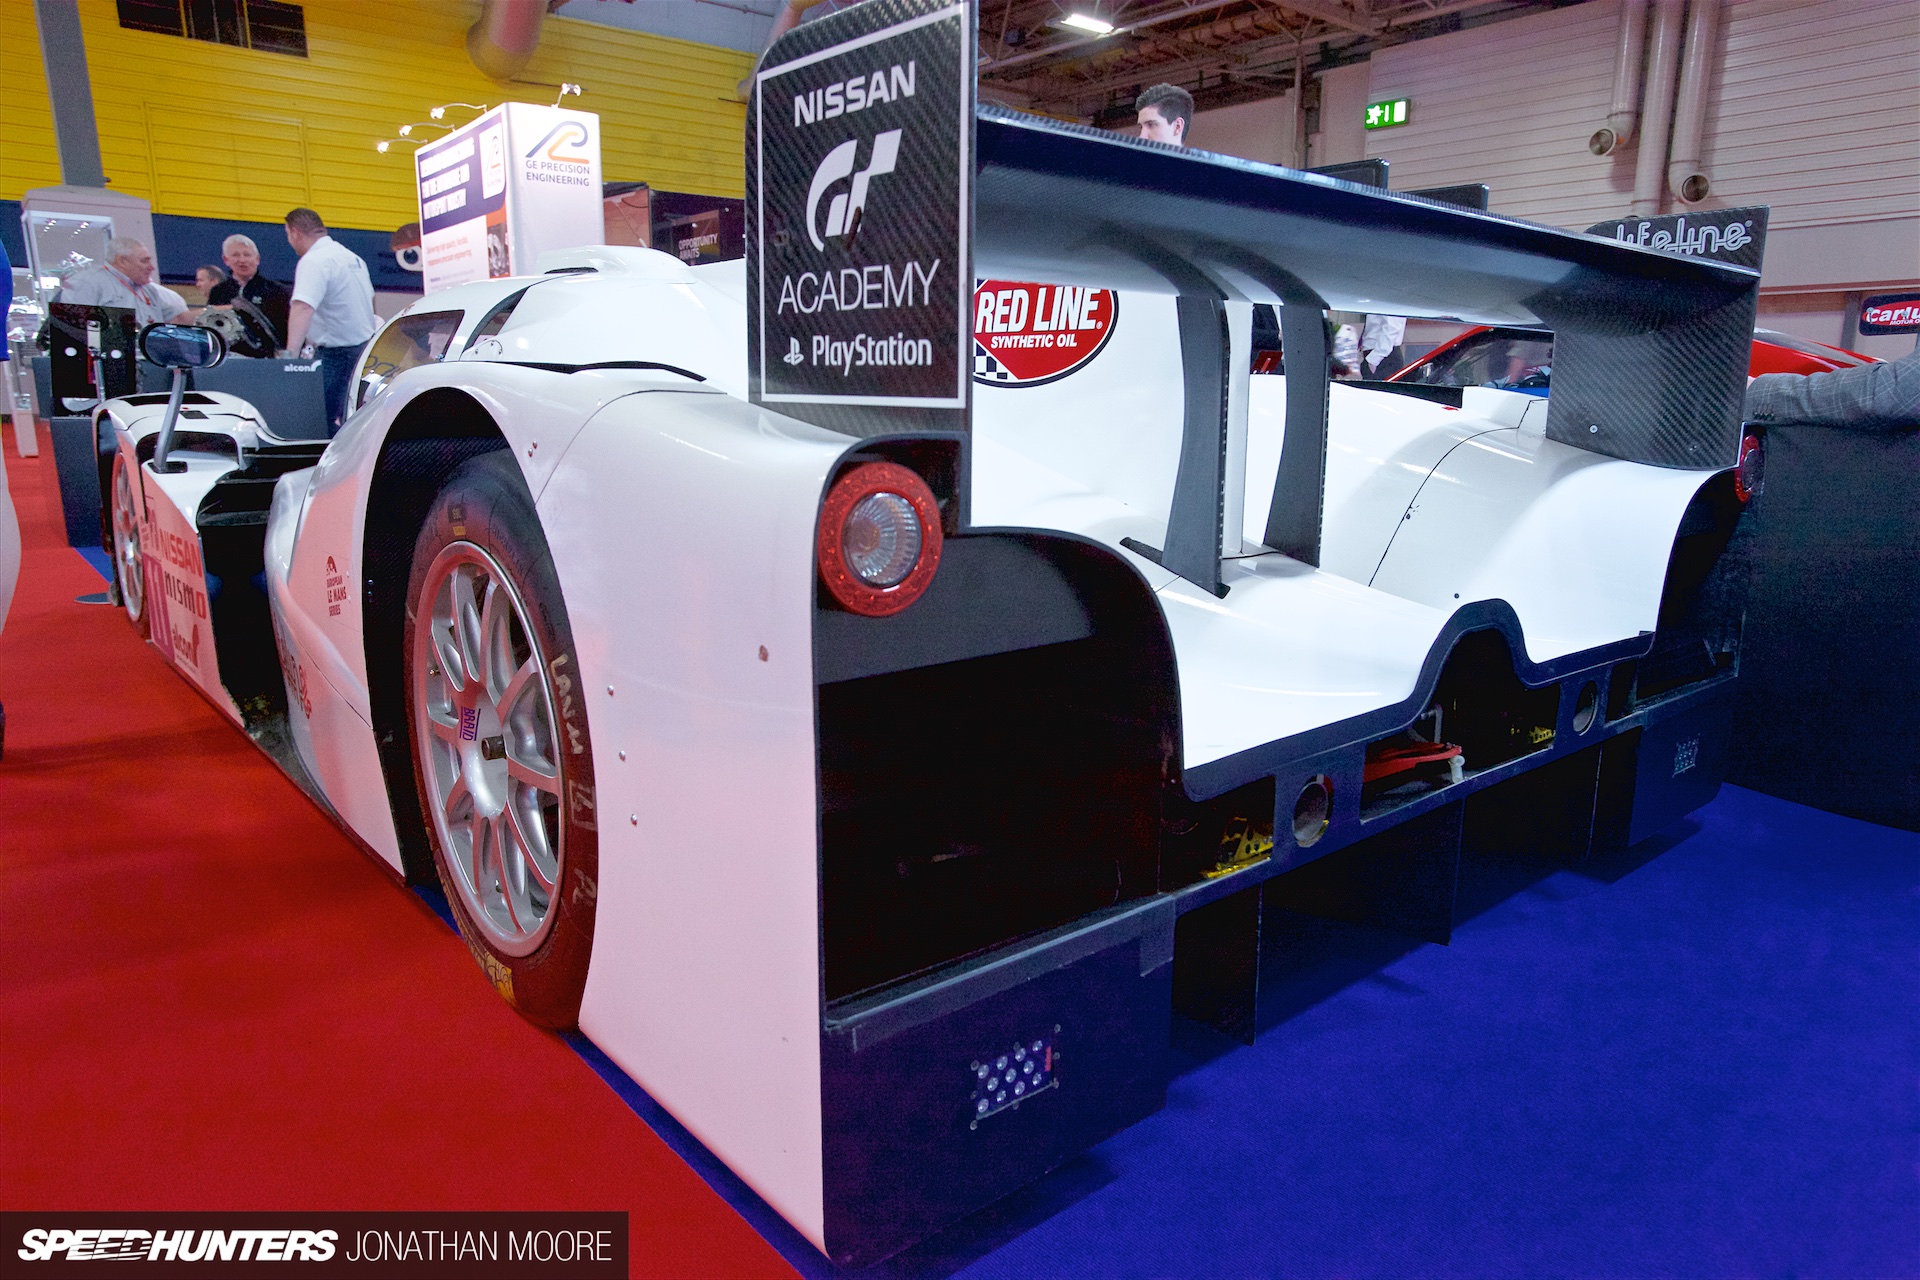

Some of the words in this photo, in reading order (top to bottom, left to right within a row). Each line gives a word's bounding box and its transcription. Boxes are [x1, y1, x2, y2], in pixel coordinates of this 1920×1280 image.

[794, 61, 915, 127] NISSAN
[525, 160, 538, 170] GE
[540, 161, 590, 175] PRECISION
[526, 172, 590, 187] ENGINEERING
[678, 233, 719, 250] OPPORTUNITY
[679, 248, 700, 259] AWAITS
[778, 258, 940, 315] ACADEMY
[975, 289, 1030, 333] RED
[1033, 286, 1101, 332] LINE
[812, 332, 932, 376] PlayStation
[990, 334, 1053, 349] SYNTHETIC
[1056, 333, 1078, 348] OIL
[283, 362, 314, 372] alcon
[159, 528, 203, 578] NISSAN
[462, 706, 476, 741] BRAID
